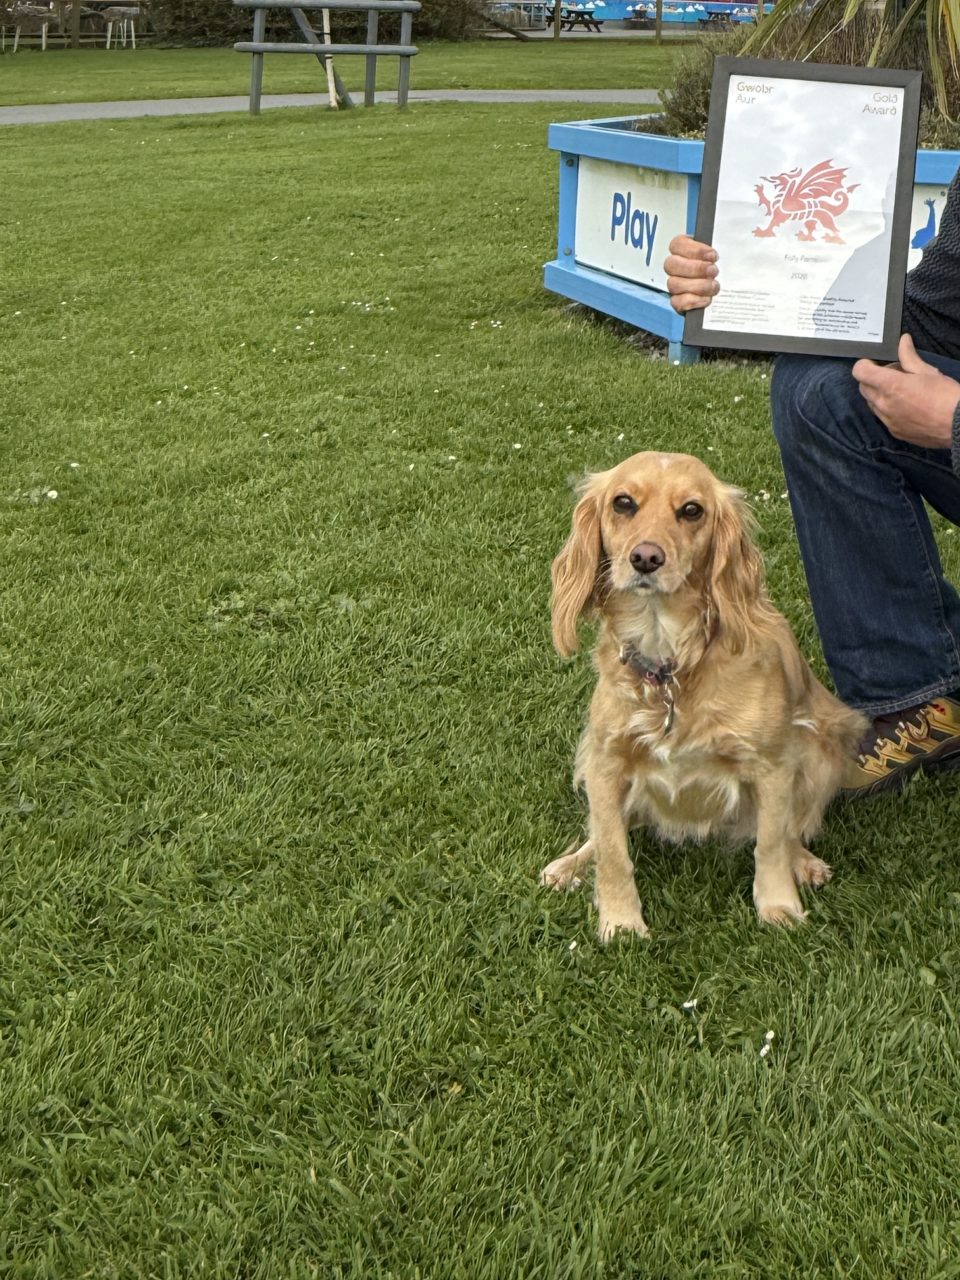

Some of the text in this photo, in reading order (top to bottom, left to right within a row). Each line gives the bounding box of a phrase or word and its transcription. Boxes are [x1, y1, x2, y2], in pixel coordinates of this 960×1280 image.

[872, 92, 898, 104] Gold
[862, 104, 897, 116] Award
[610, 191, 659, 267] Play
